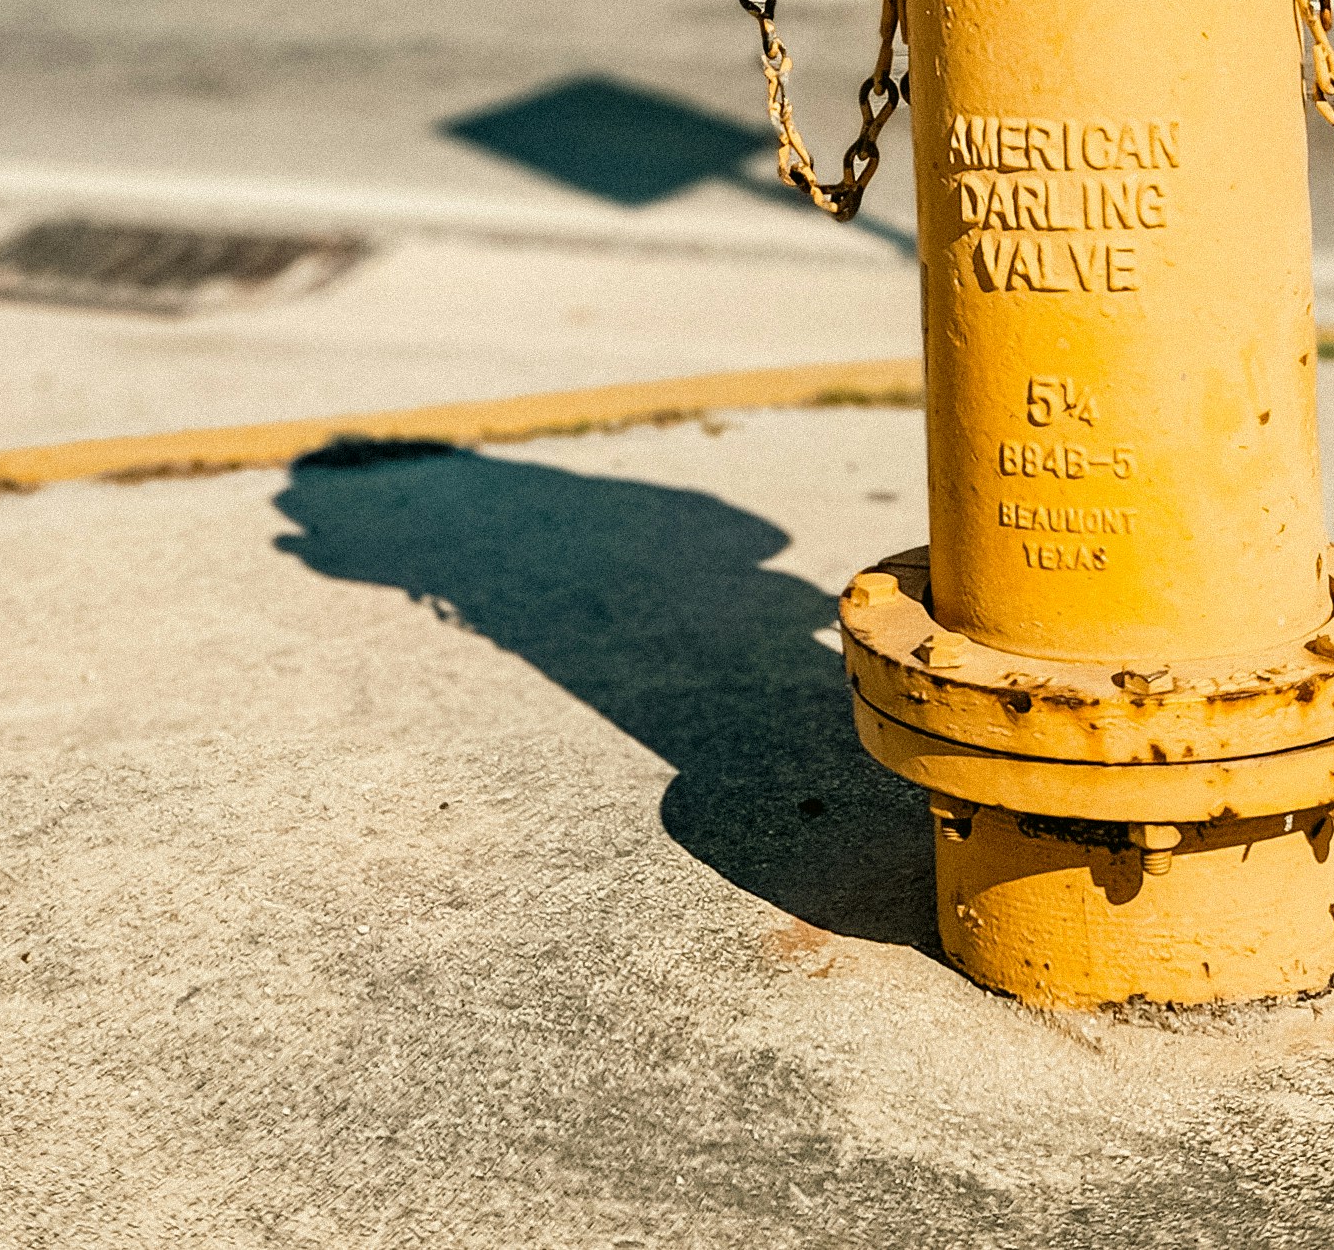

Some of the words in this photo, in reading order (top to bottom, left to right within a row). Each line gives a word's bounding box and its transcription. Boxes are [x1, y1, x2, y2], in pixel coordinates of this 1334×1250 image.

[949, 114, 1182, 173] AMERICAN
[959, 175, 1169, 232] DARLING
[973, 235, 1140, 294] VALVE
[997, 500, 1138, 536] BEAUMONT
[1021, 540, 1108, 572] TEXAS
